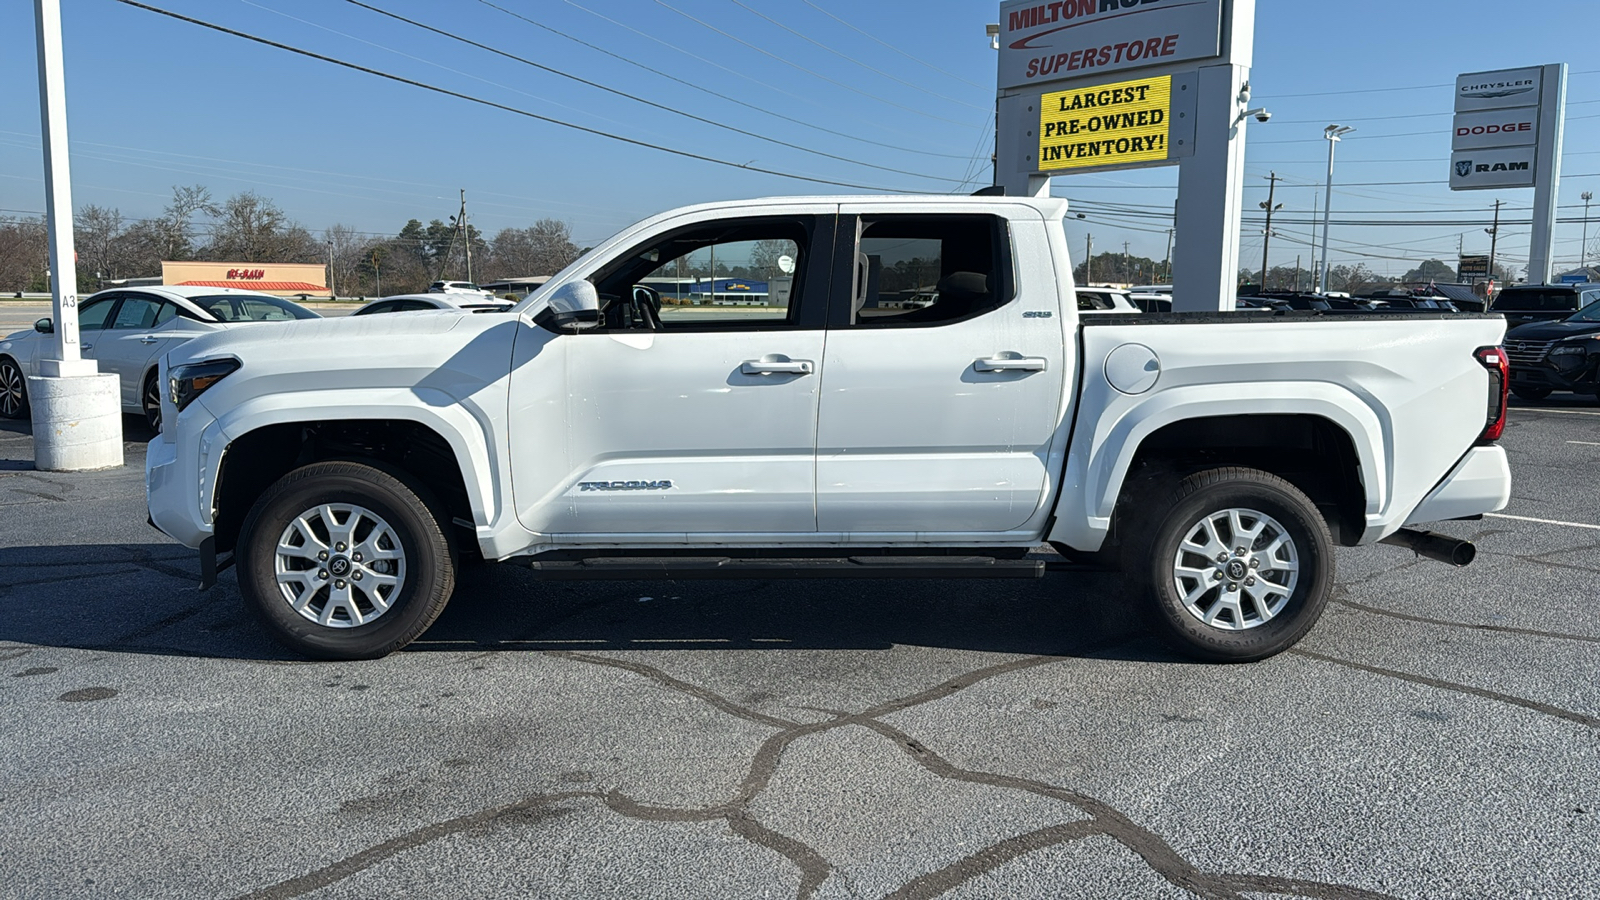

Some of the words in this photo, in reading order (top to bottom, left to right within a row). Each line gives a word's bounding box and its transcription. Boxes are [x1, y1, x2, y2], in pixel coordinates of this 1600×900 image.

[1008, 0, 1096, 31] MILTON
[1026, 35, 1179, 78] SUPERSTORE
[1461, 79, 1533, 91] CHRYSLER
[1059, 85, 1150, 111] LARGEST
[1044, 109, 1164, 137] PRE-OWNED
[1456, 122, 1532, 136] DODGE
[1042, 134, 1164, 161] INVENTORY!
[1475, 161, 1529, 173] RAM
[62, 295, 76, 308] A3
[577, 481, 673, 491] TACOMA
